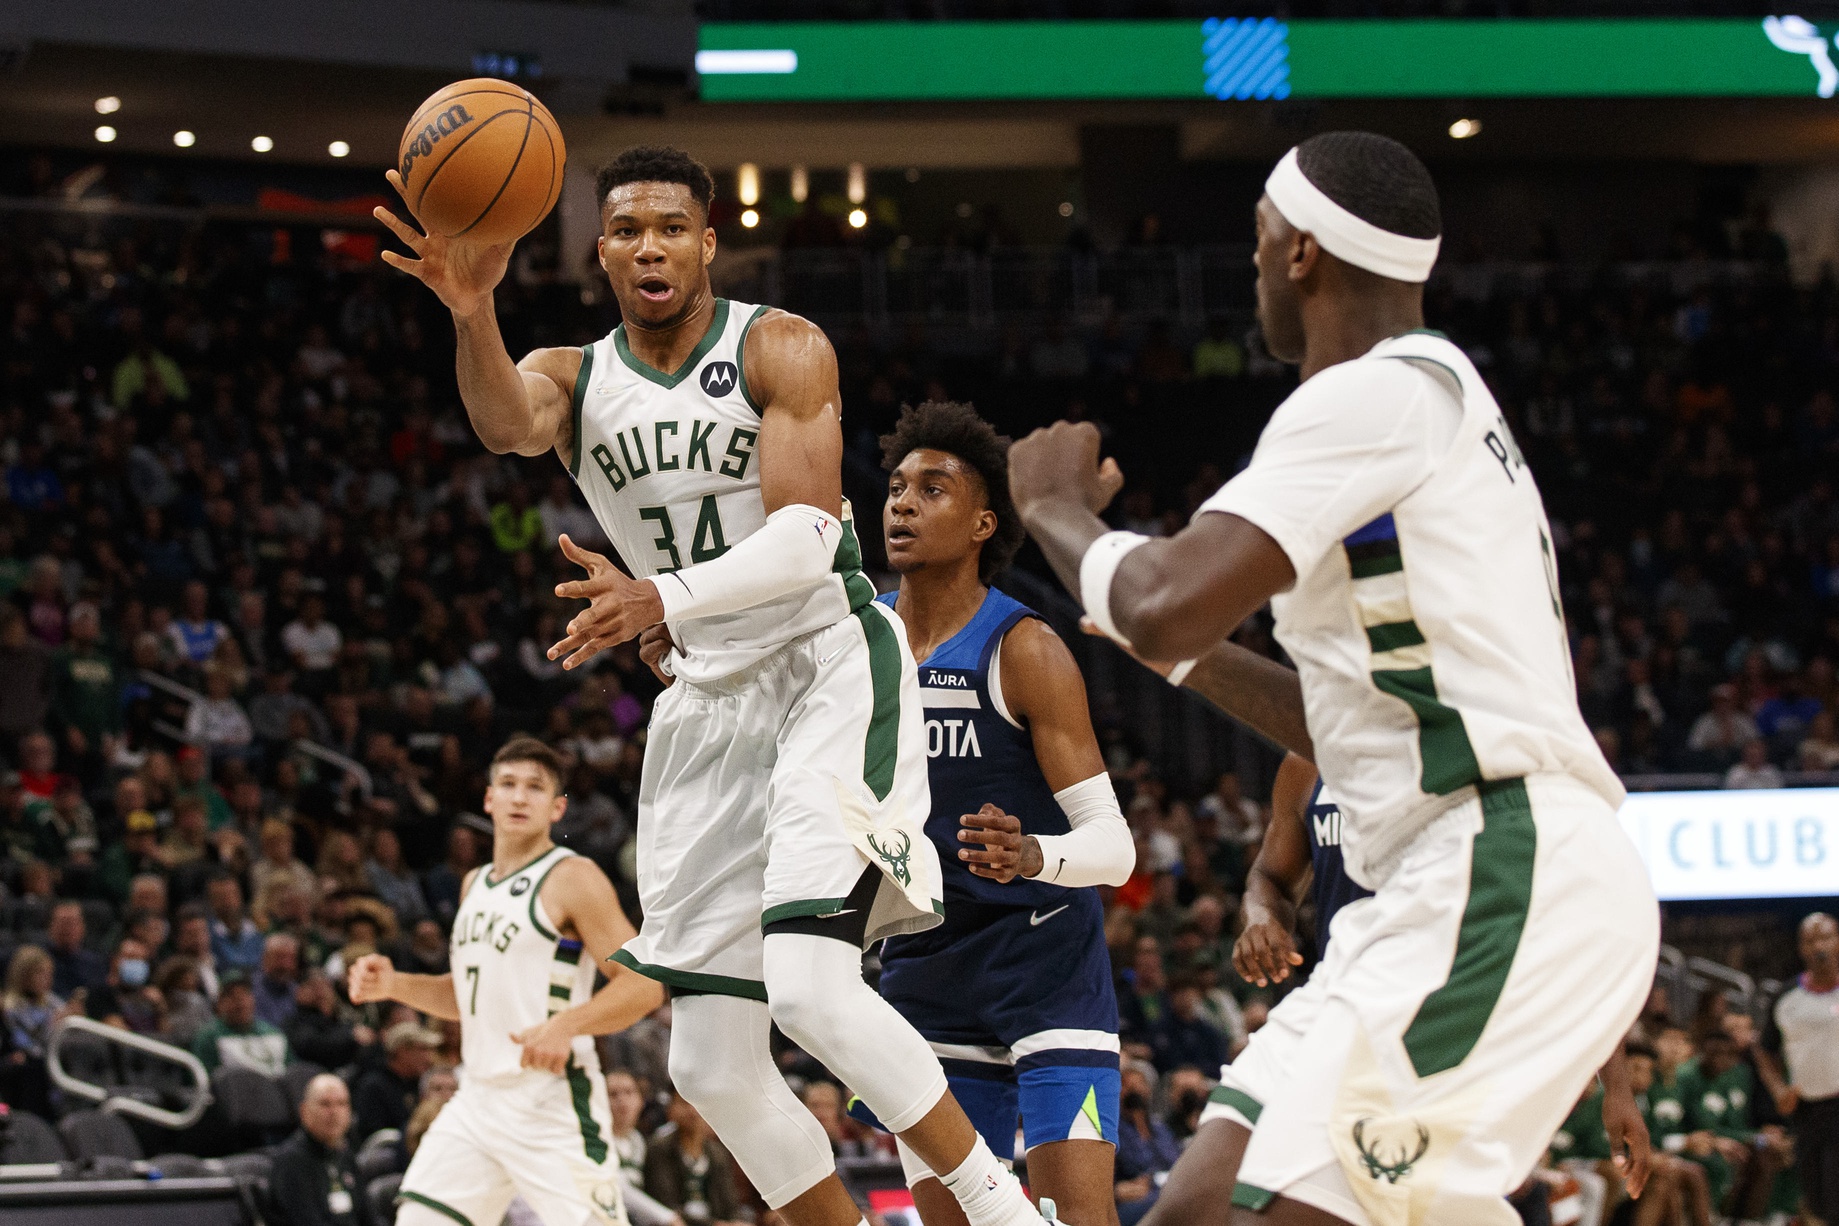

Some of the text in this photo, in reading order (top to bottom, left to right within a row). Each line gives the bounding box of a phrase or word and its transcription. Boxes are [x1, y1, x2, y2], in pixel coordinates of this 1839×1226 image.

[590, 419, 758, 495] BUCKS
[638, 493, 732, 575] 34
[923, 719, 982, 758] OTA
[1313, 811, 1345, 847] MI
[1668, 816, 1828, 871] CLUB
[466, 965, 479, 1016] 7
